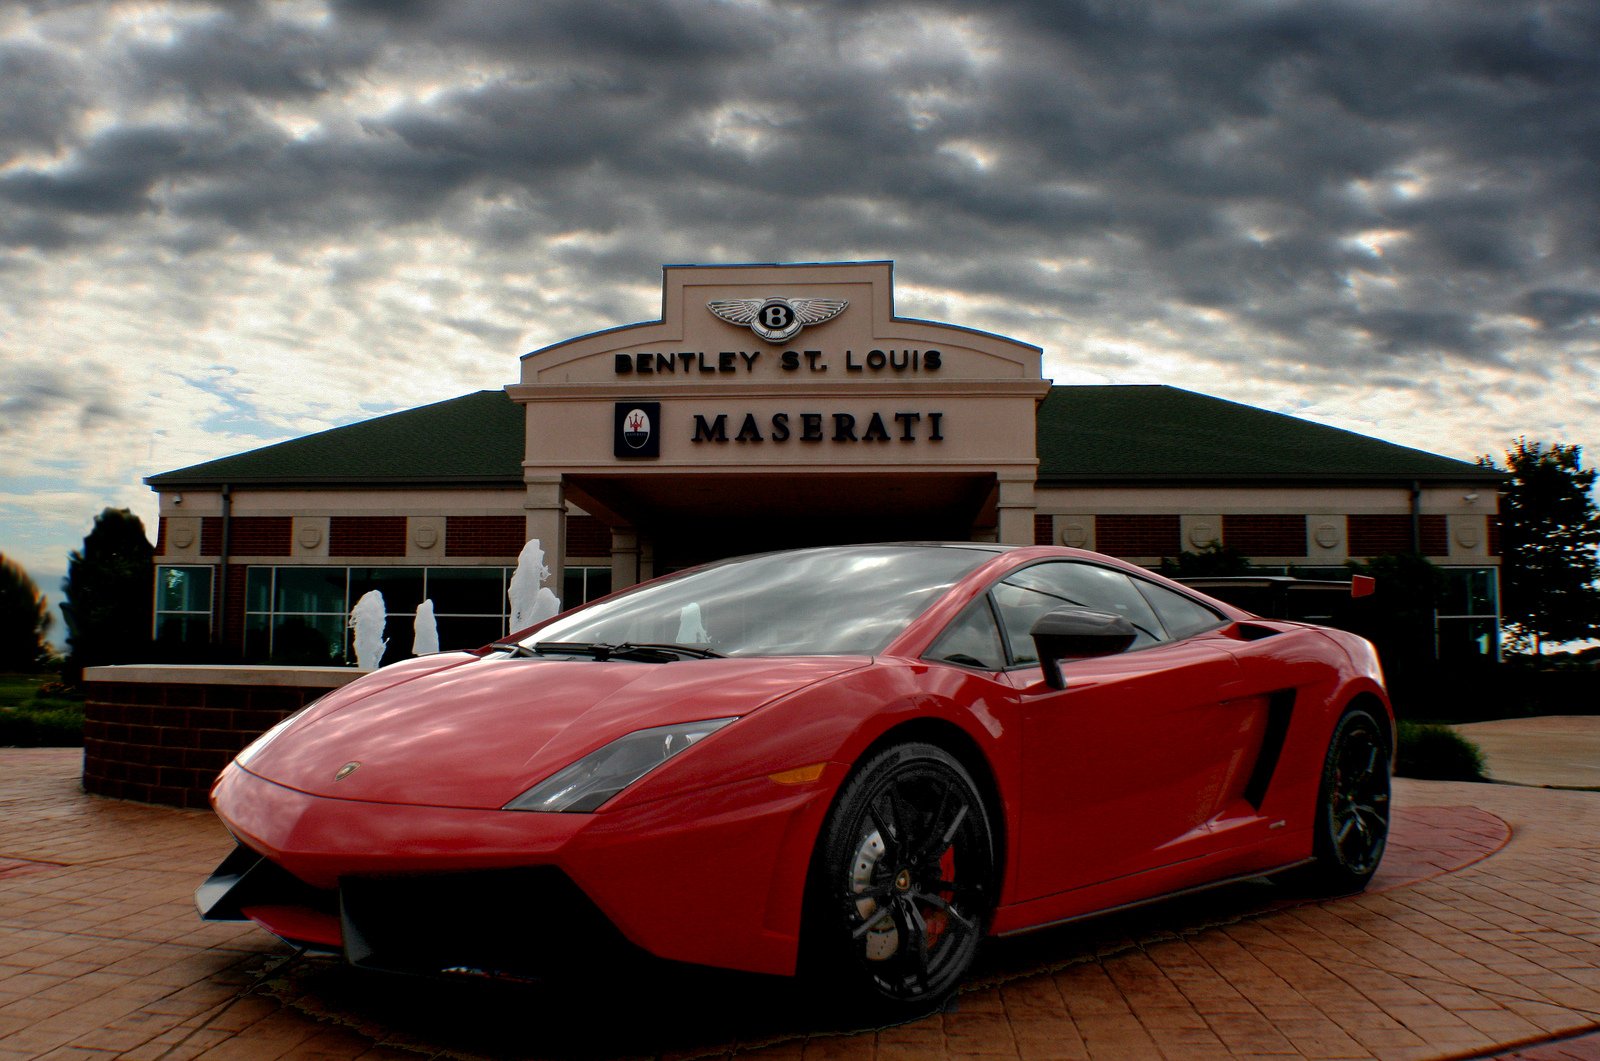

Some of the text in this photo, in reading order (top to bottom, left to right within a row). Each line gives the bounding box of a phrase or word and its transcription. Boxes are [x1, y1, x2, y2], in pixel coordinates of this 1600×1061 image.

[766, 308, 787, 328] B
[615, 350, 942, 373] BENTLEY ST. LOUIS
[691, 412, 943, 442] MASERATI
